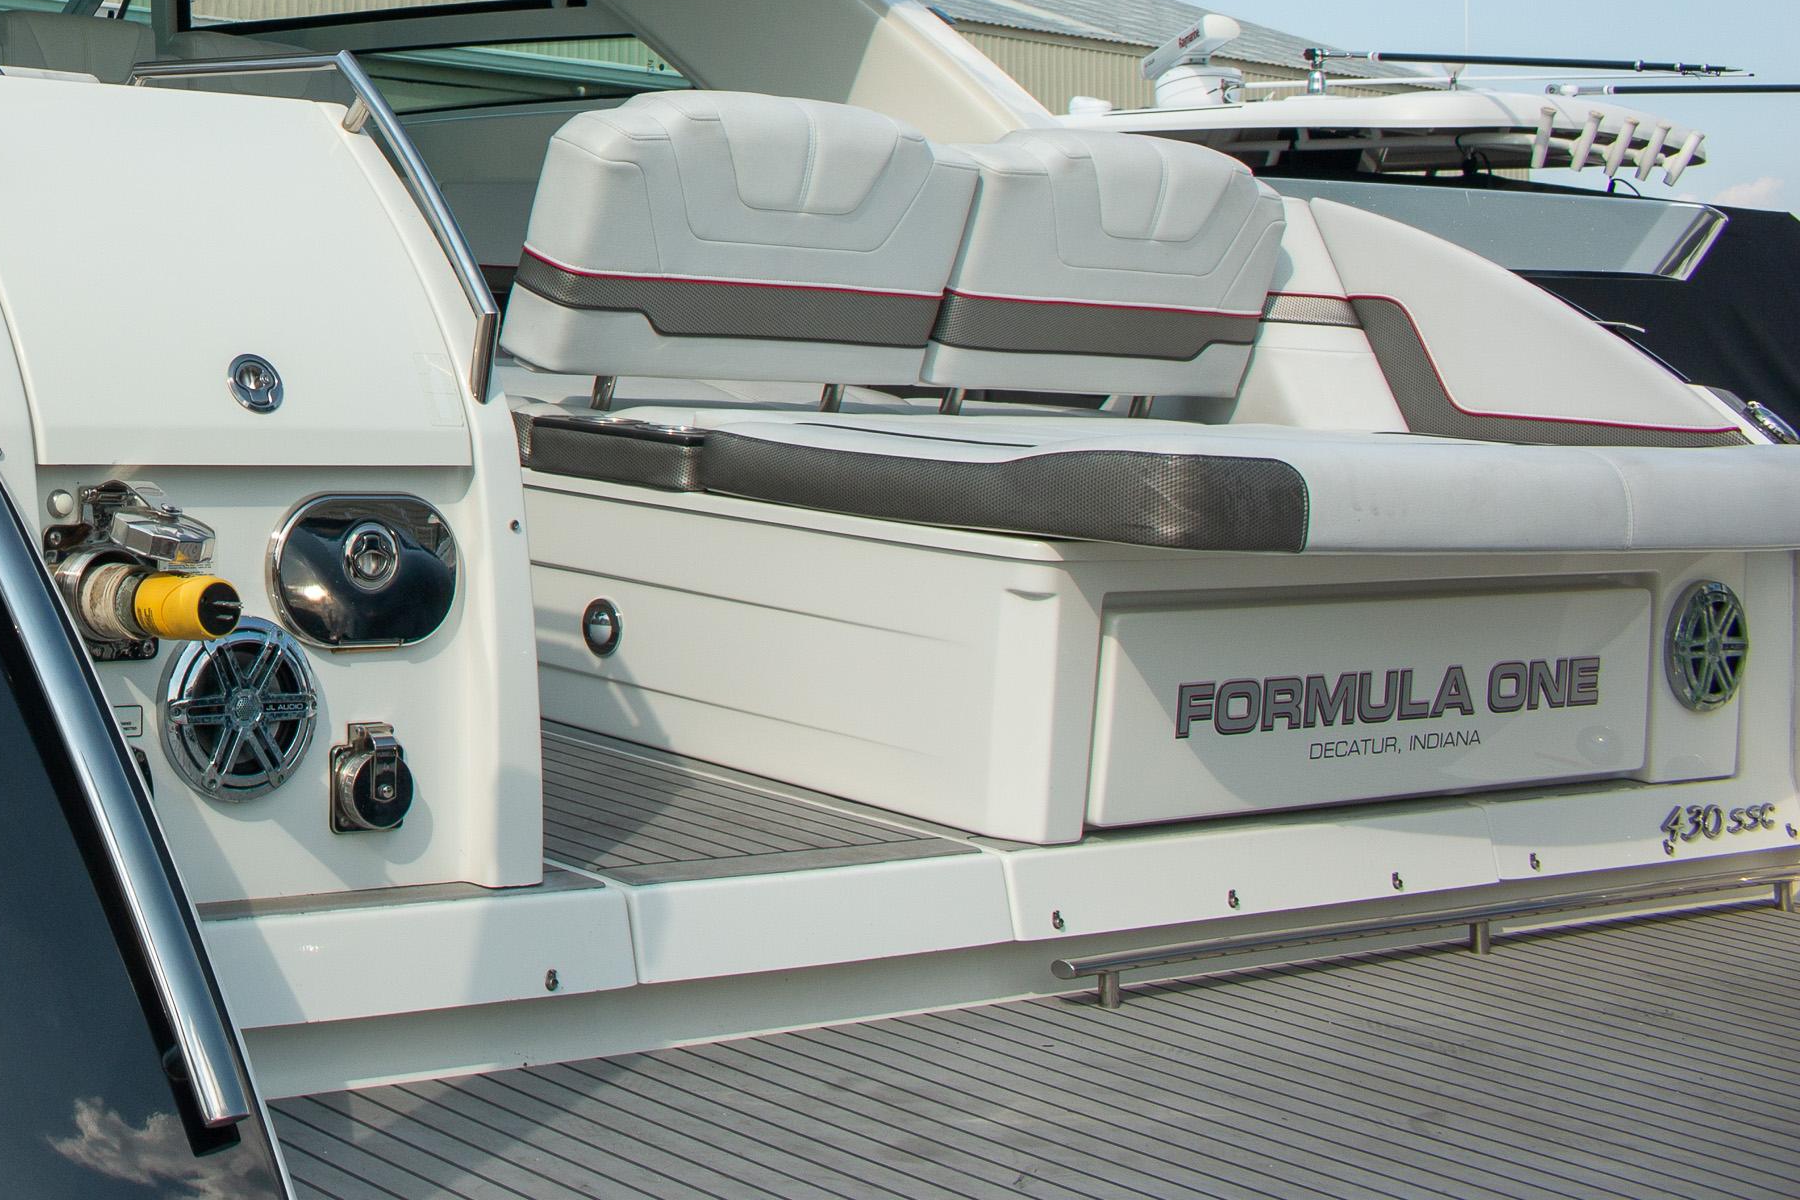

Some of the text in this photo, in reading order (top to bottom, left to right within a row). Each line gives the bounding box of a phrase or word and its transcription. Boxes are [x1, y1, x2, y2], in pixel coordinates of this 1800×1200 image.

[1175, 655, 1600, 739] FORMULA ONE
[1309, 730, 1481, 760] DECATUR, INDIANA
[1660, 804, 1722, 842] 430
